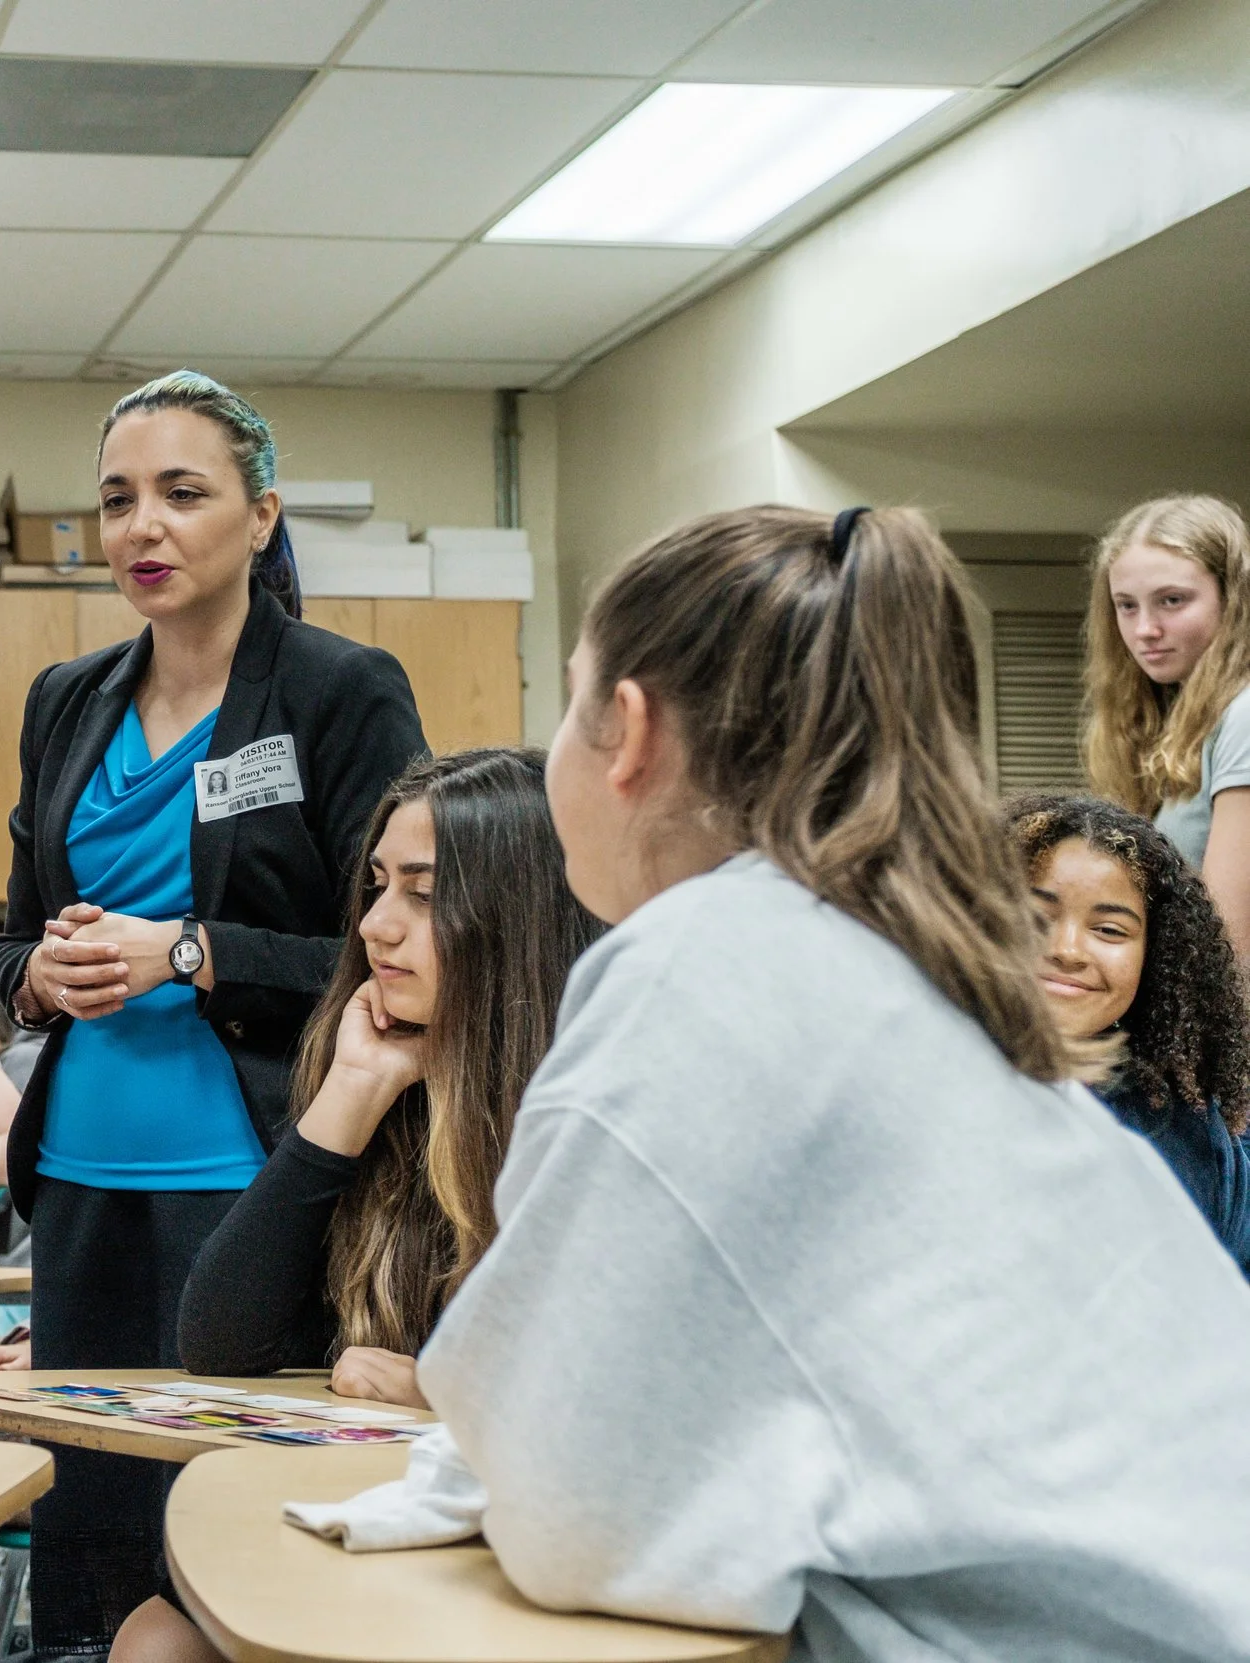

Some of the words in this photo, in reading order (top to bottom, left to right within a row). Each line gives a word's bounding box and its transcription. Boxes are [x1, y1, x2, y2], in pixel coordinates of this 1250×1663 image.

[240, 740, 284, 760] VISITOR
[235, 770, 260, 782] Tiffany
[262, 765, 281, 774] Vora
[235, 777, 265, 789] Classroom
[205, 800, 228, 808] Ransom
[229, 789, 258, 802] Everglades
[259, 784, 277, 793] Upper
